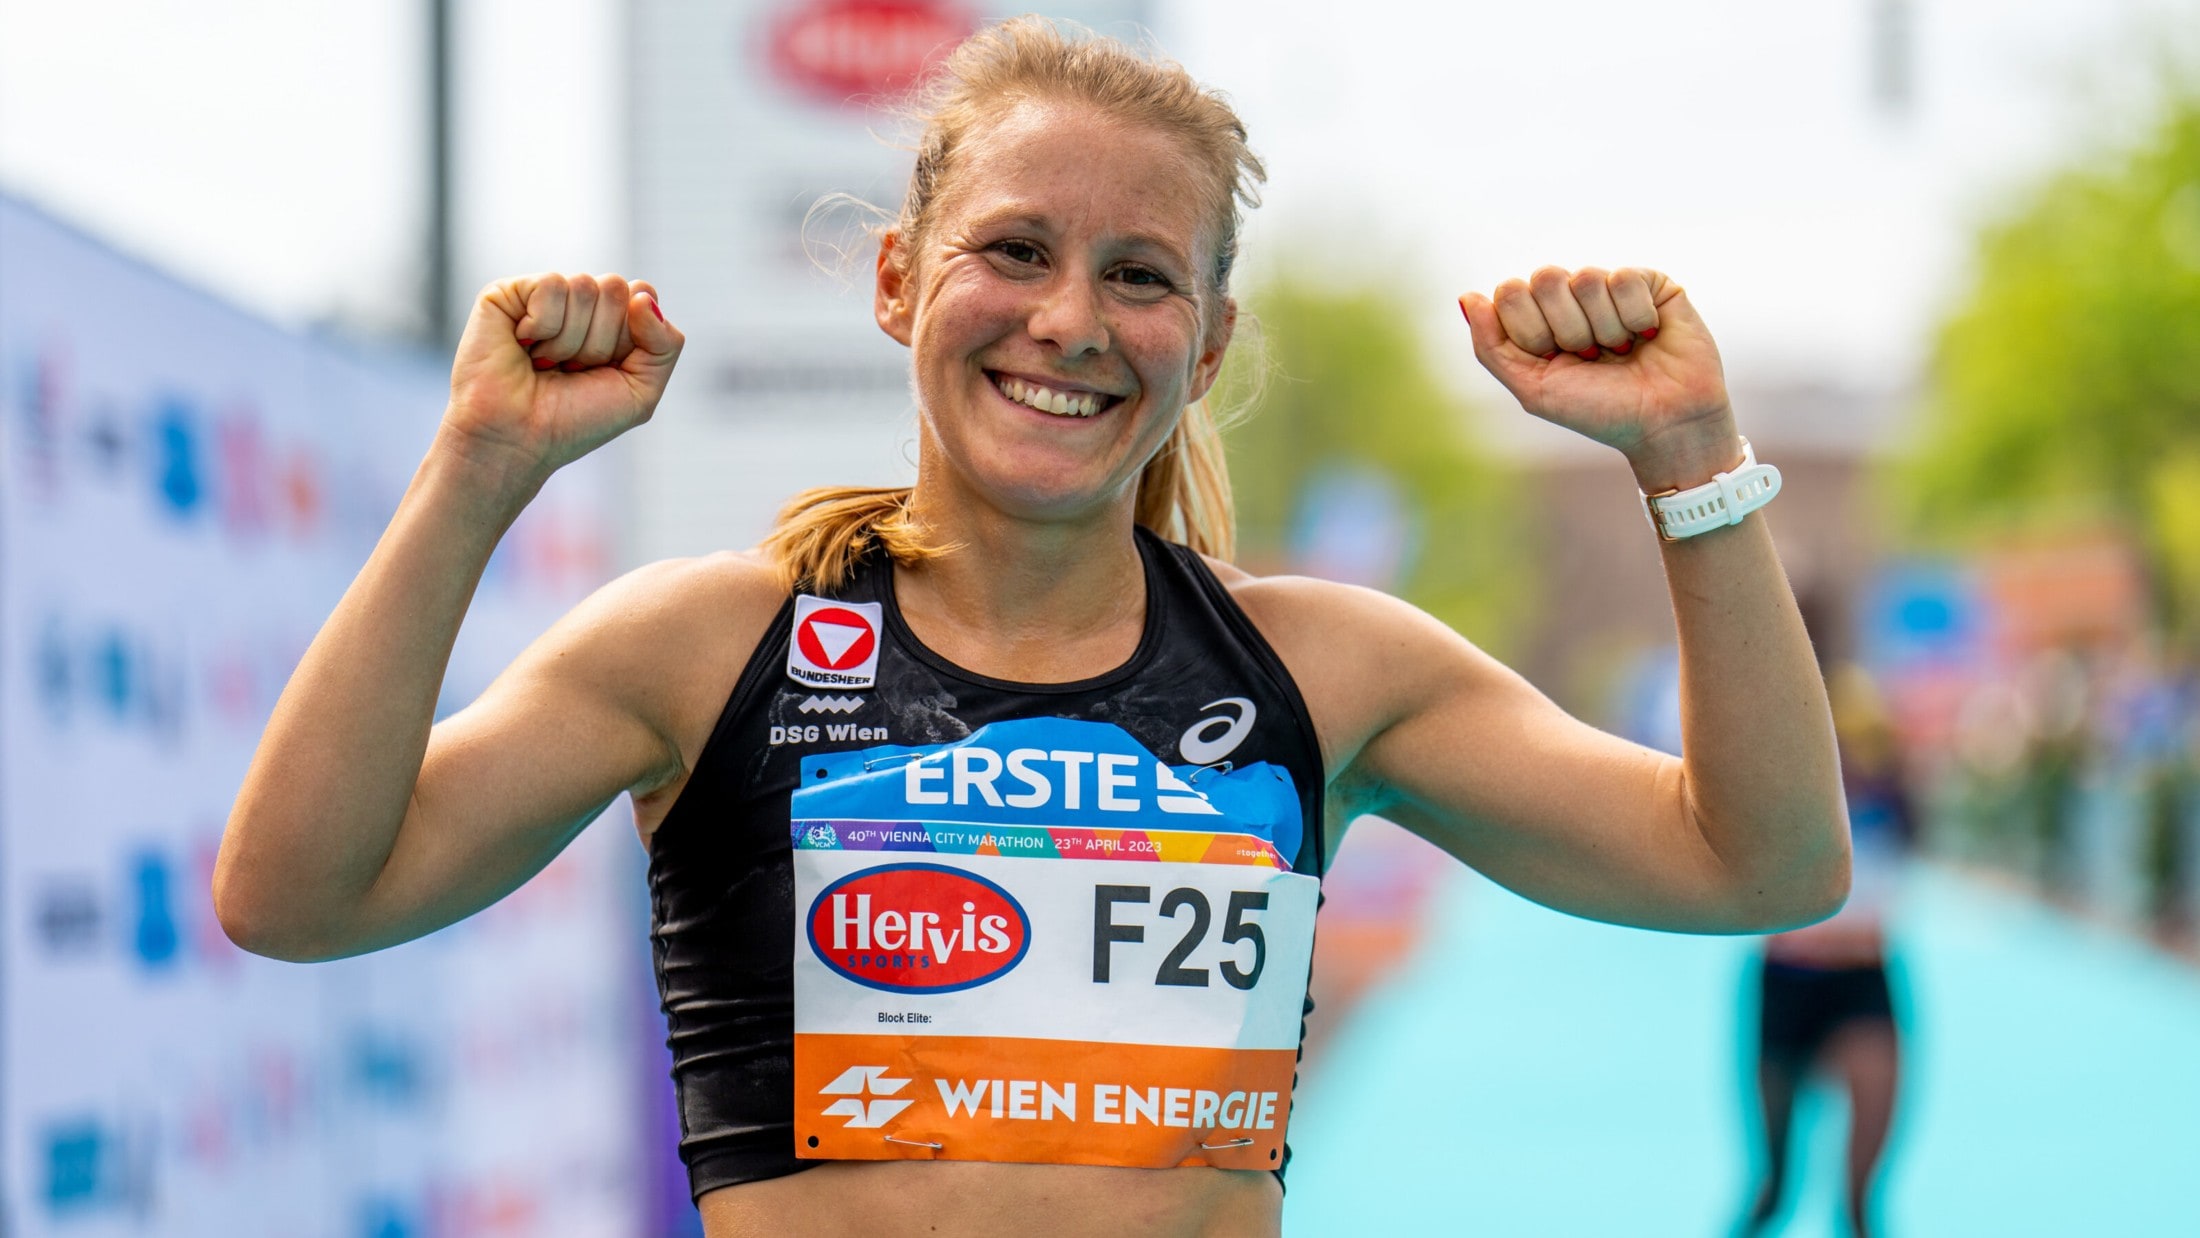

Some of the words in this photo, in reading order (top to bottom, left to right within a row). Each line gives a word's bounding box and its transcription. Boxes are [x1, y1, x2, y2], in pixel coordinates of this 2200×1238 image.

[791, 666, 871, 684] BUNDESHEER
[770, 725, 820, 745] DSG
[826, 723, 889, 741] Wien
[905, 747, 1141, 812] ERSTE
[847, 830, 877, 842] 40TH
[880, 831, 931, 843] VIENNA
[935, 832, 964, 845] CITY
[968, 833, 1044, 849] MARATHON
[1054, 838, 1082, 850] 23TH
[1085, 838, 1125, 852] APRIL
[1128, 840, 1162, 853] 2023
[832, 893, 1011, 964] Hervis
[1093, 884, 1270, 990] F25
[847, 955, 930, 969] SPORTS
[878, 1012, 905, 1023] Block
[907, 1012, 932, 1024] Elite:
[934, 1078, 1077, 1123] WIEN
[1093, 1084, 1278, 1131] ENERGIE
